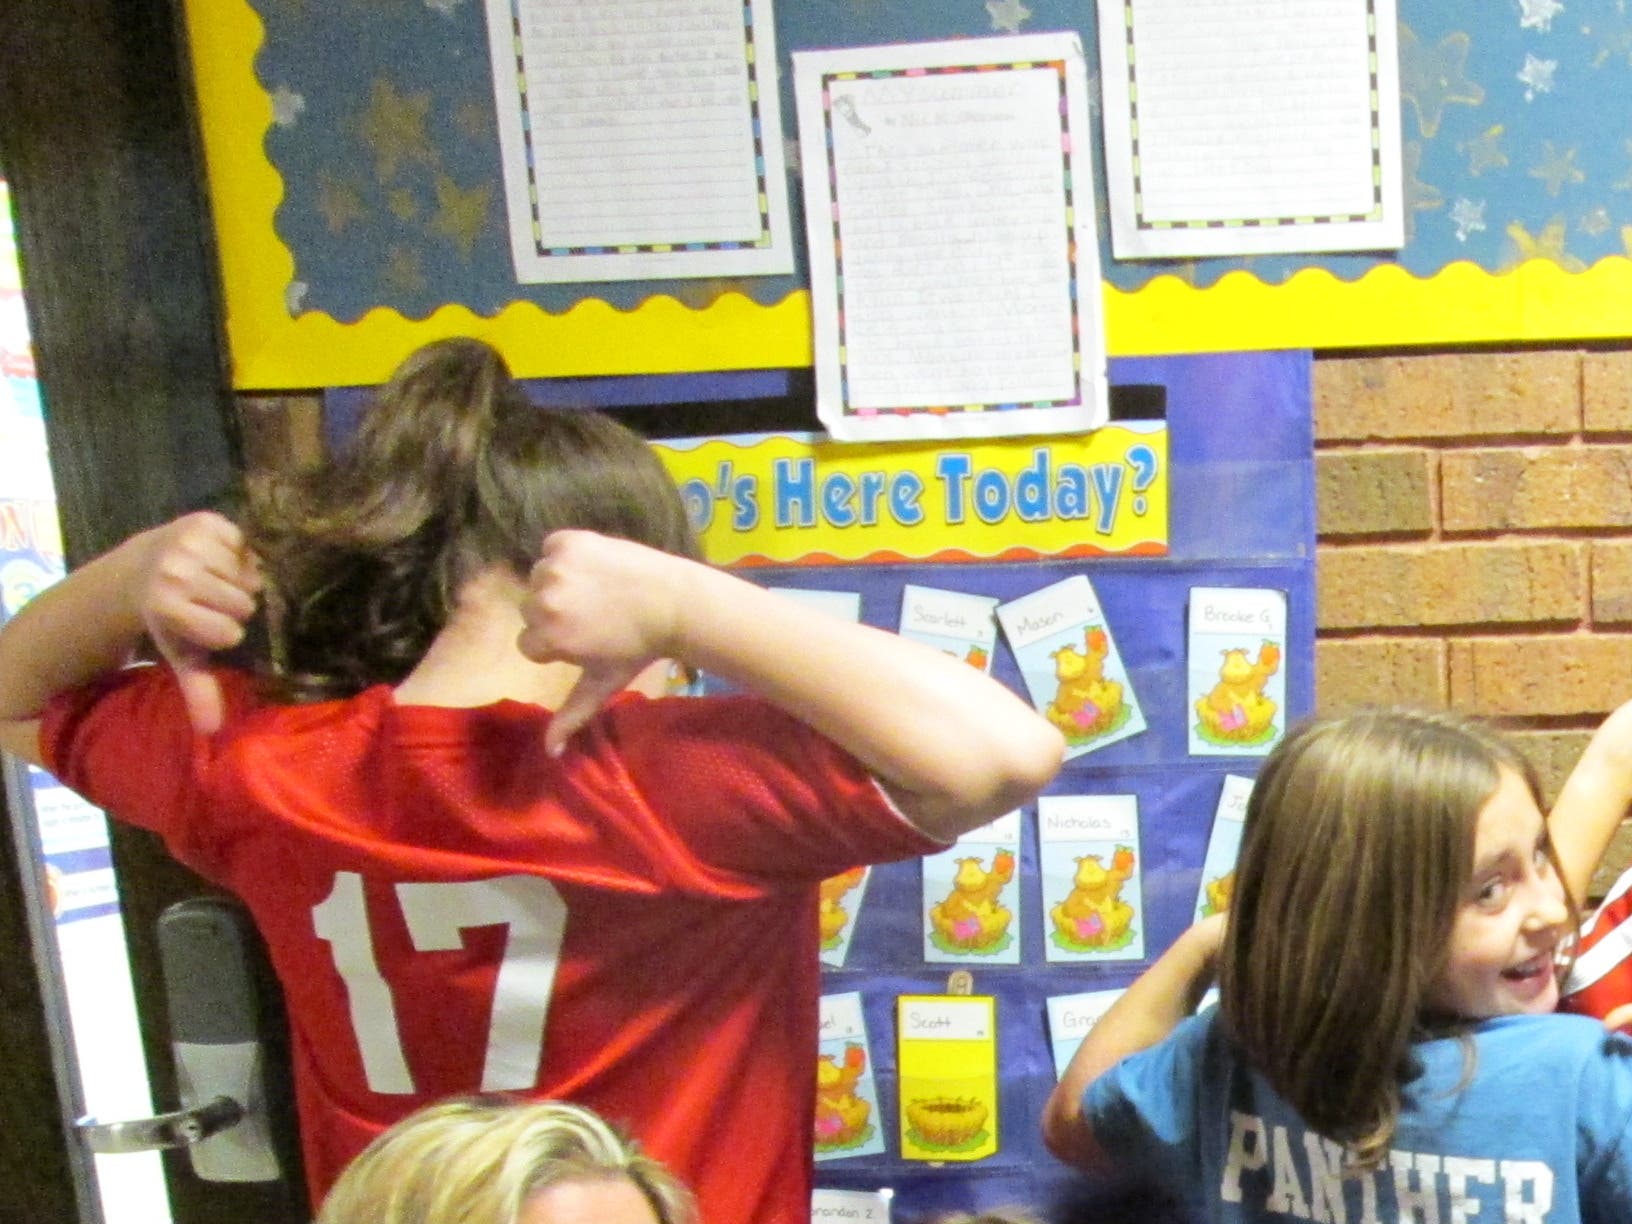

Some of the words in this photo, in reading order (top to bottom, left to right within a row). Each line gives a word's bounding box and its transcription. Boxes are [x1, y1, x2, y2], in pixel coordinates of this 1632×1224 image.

[774, 457, 925, 530] Here
[934, 443, 1158, 536] Today?
[1204, 604, 1256, 624] Brooke
[1046, 812, 1113, 830] Nicholas
[311, 870, 569, 1095] 17
[910, 1011, 952, 1030] Scott
